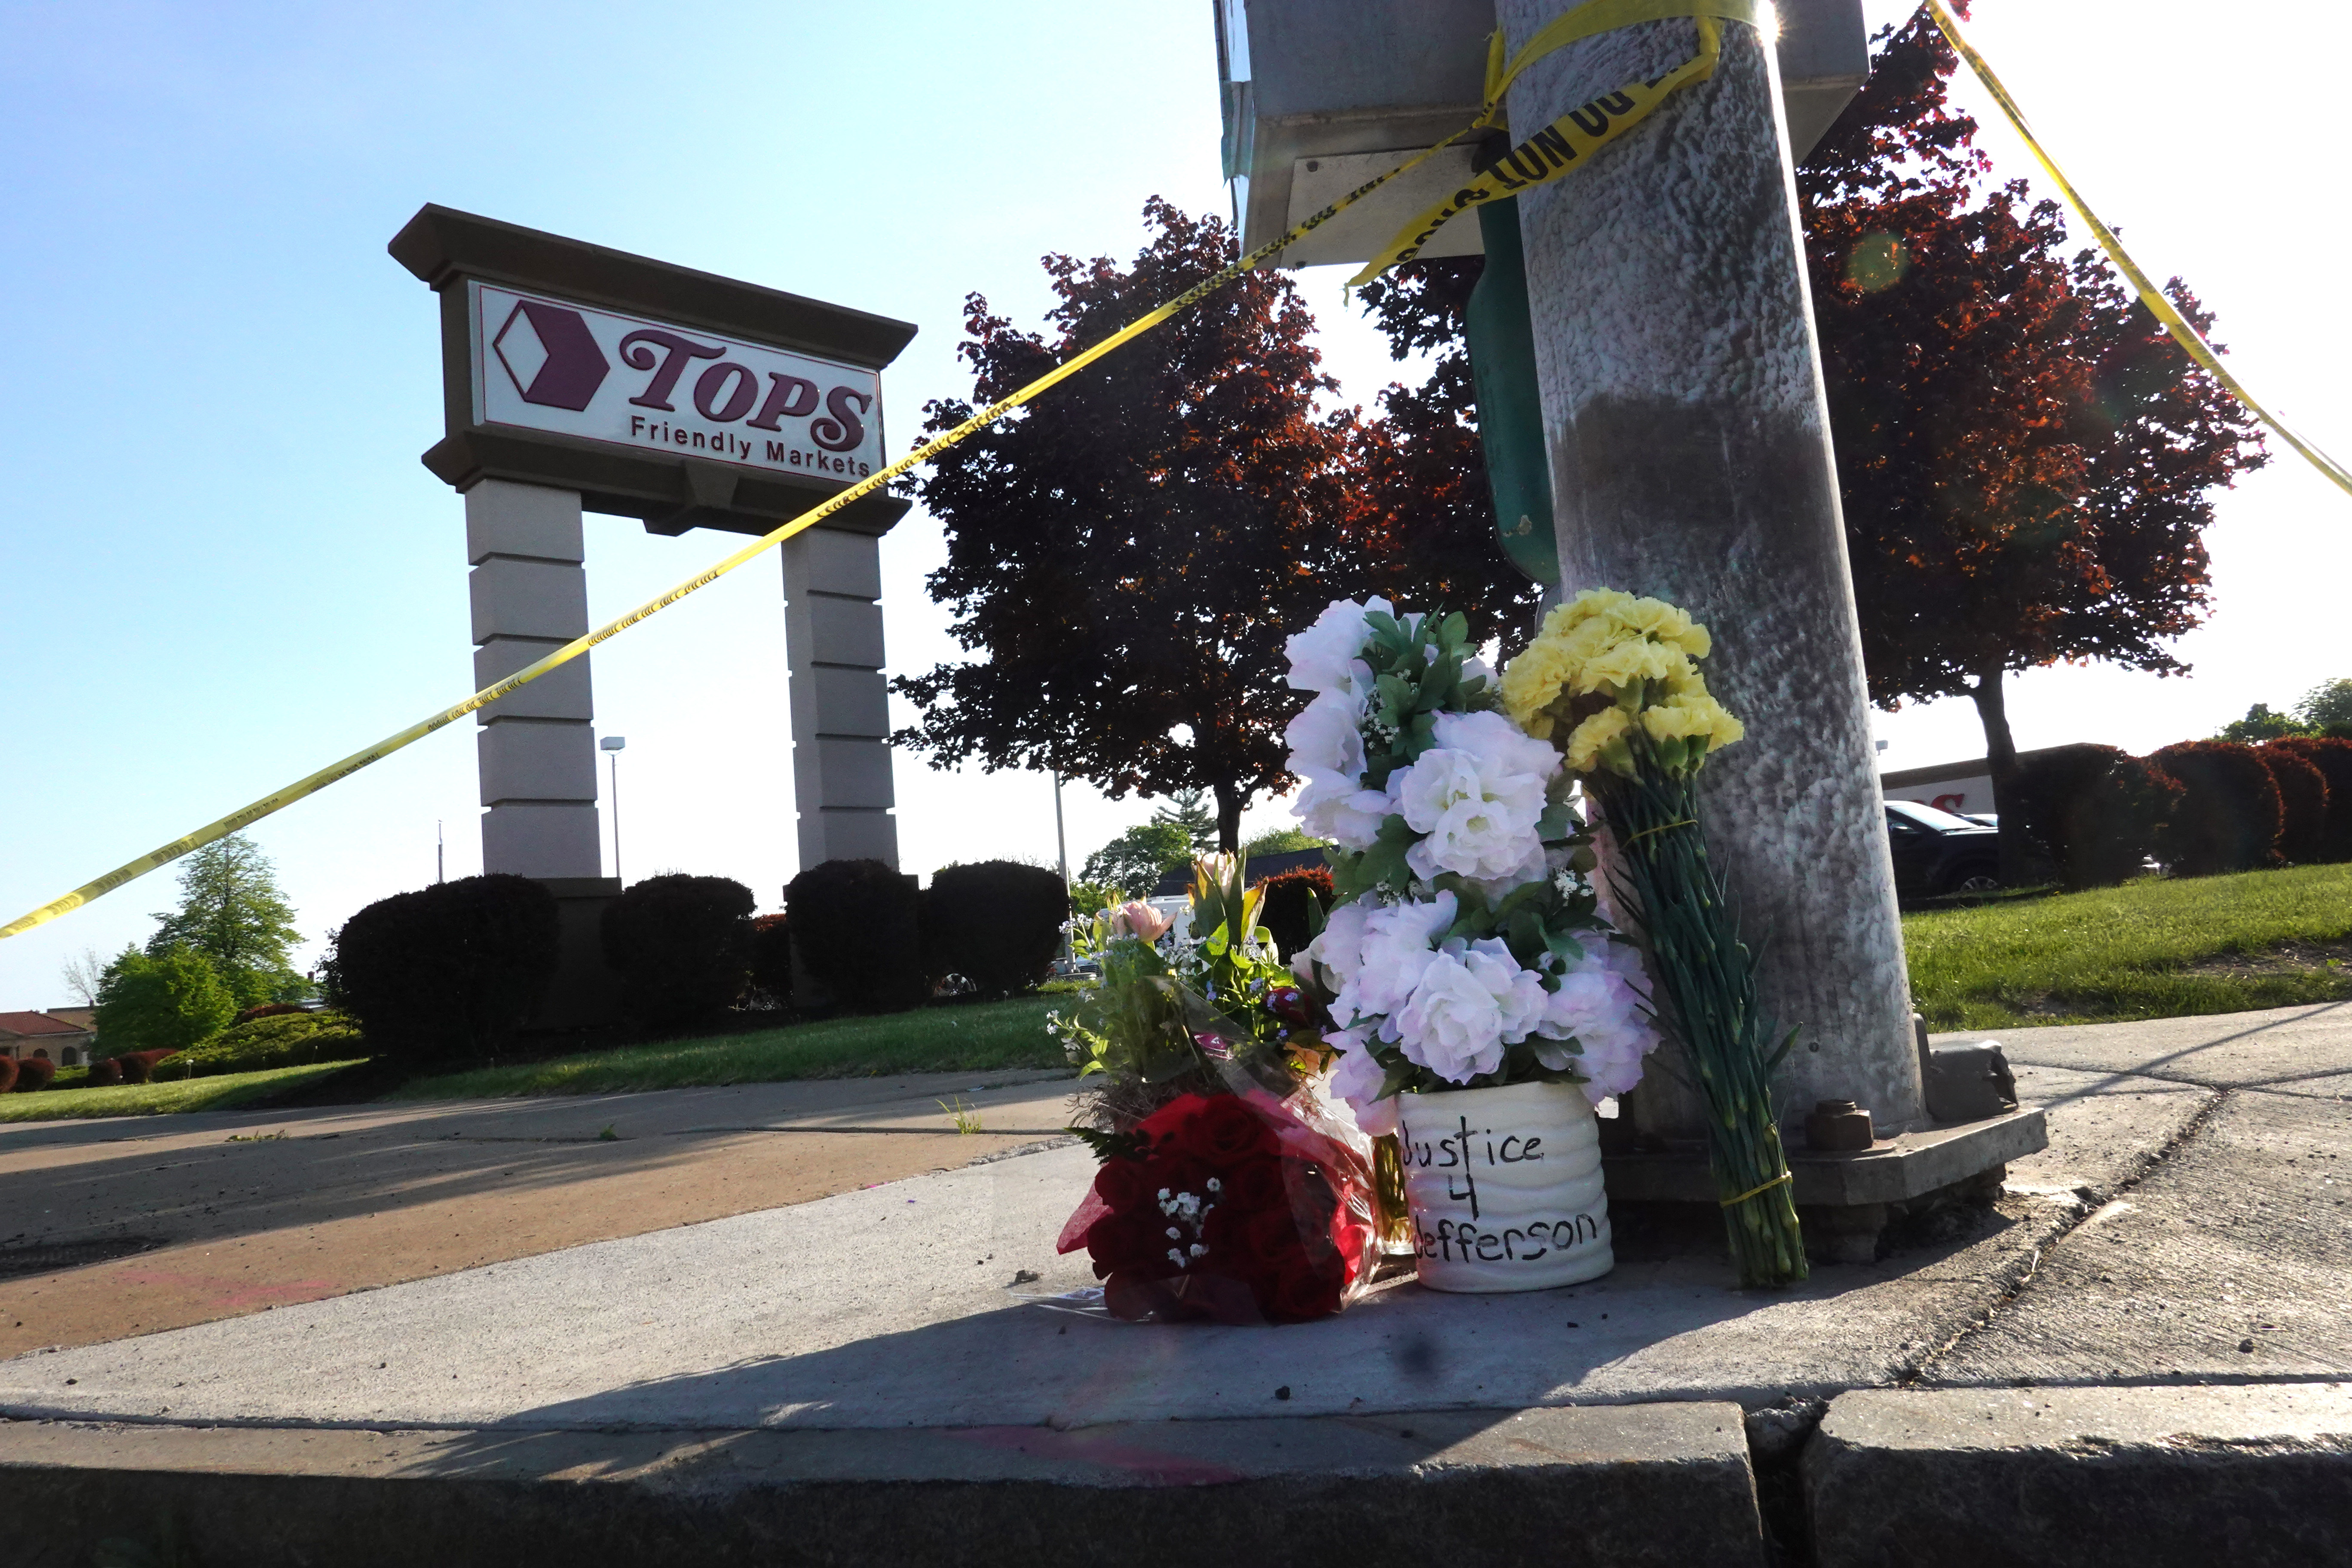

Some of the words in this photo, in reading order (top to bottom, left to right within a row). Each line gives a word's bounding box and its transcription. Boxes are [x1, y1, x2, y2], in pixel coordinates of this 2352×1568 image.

[631, 415, 751, 460] Friendly
[766, 440, 870, 478] Markets
[1402, 1115, 1544, 1173] Justice
[1449, 1173, 1479, 1221] 4
[1413, 1213, 1598, 1263] Jefferson
